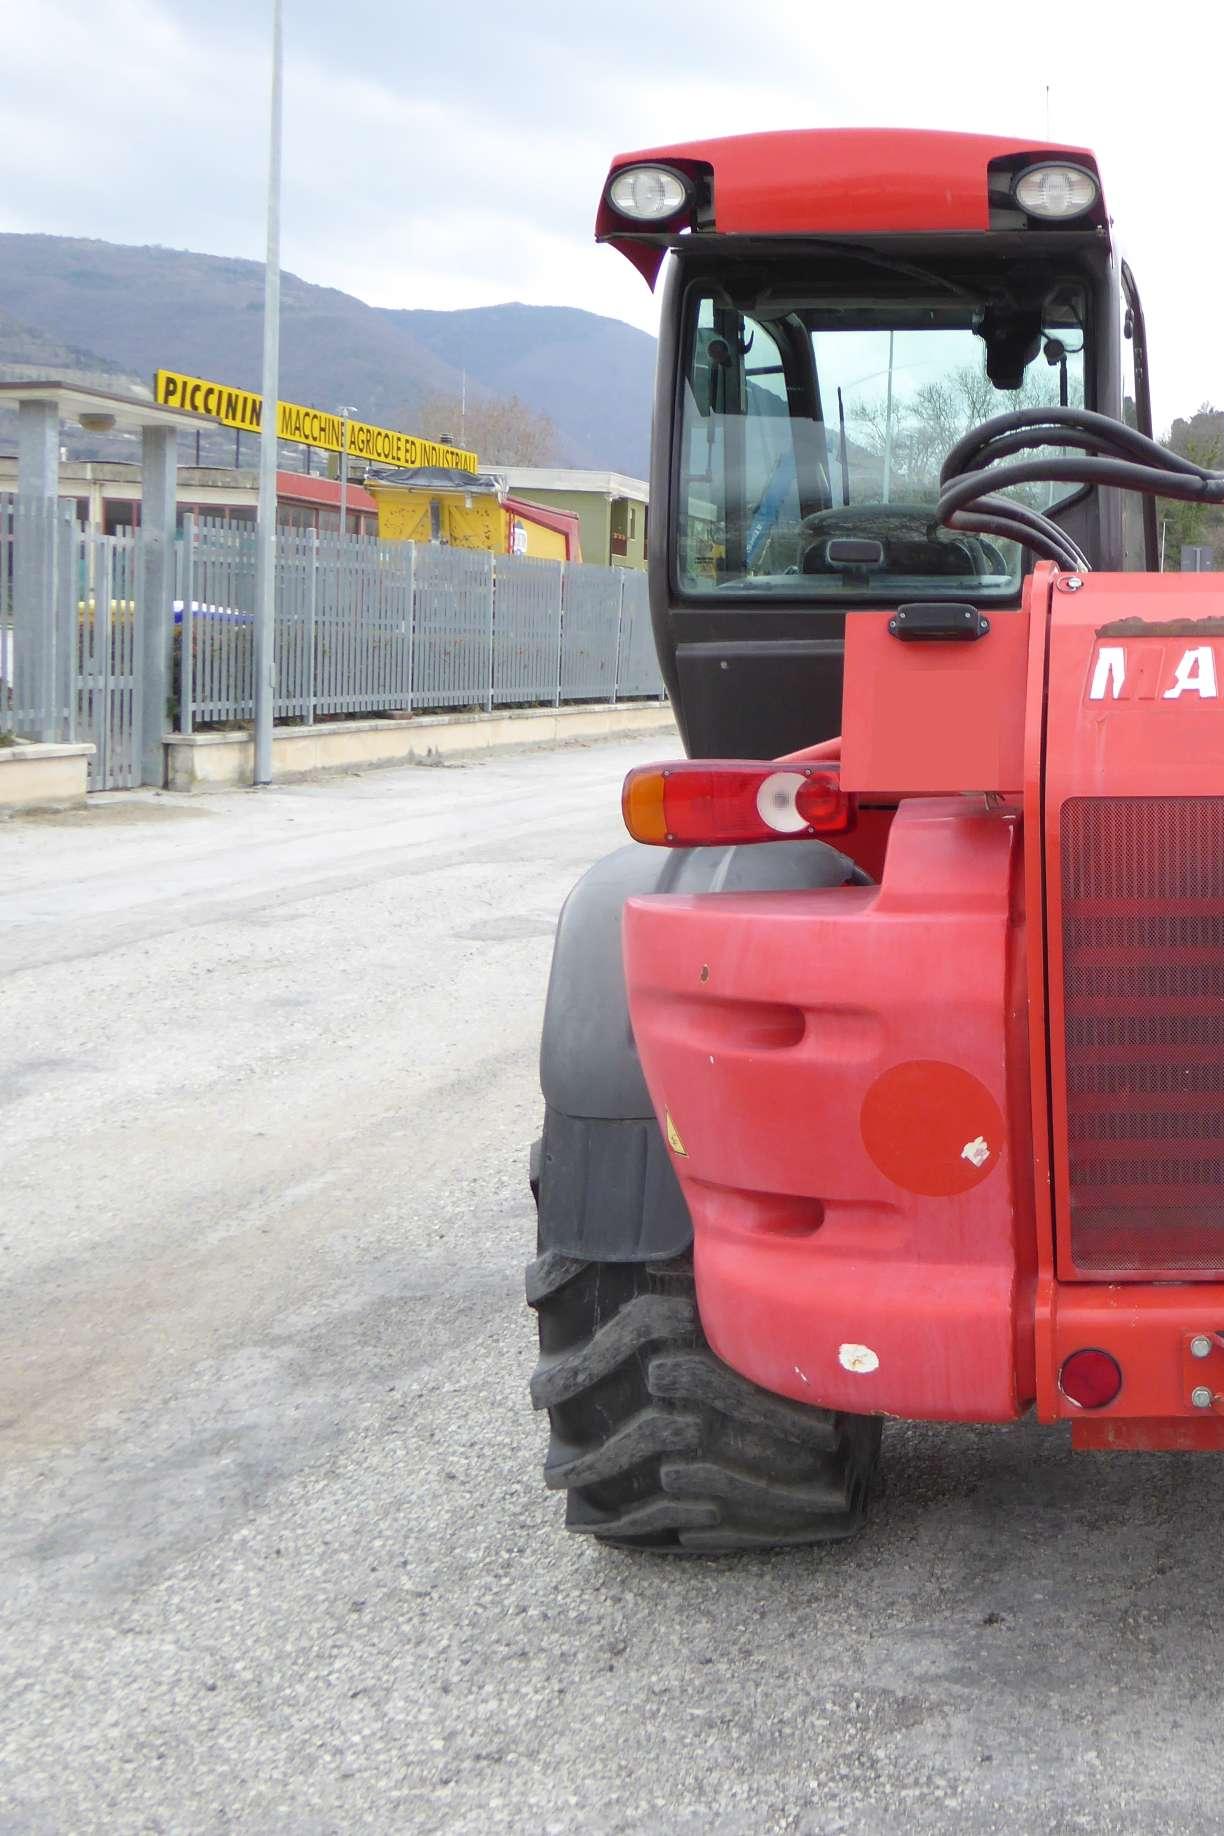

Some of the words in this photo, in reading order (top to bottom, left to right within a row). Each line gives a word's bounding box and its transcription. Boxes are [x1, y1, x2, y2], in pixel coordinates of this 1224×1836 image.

[164, 376, 263, 427] PICCININ
[281, 405, 345, 448] MACCHINE
[349, 423, 402, 462] AGRICOLE
[404, 438, 417, 465] ED
